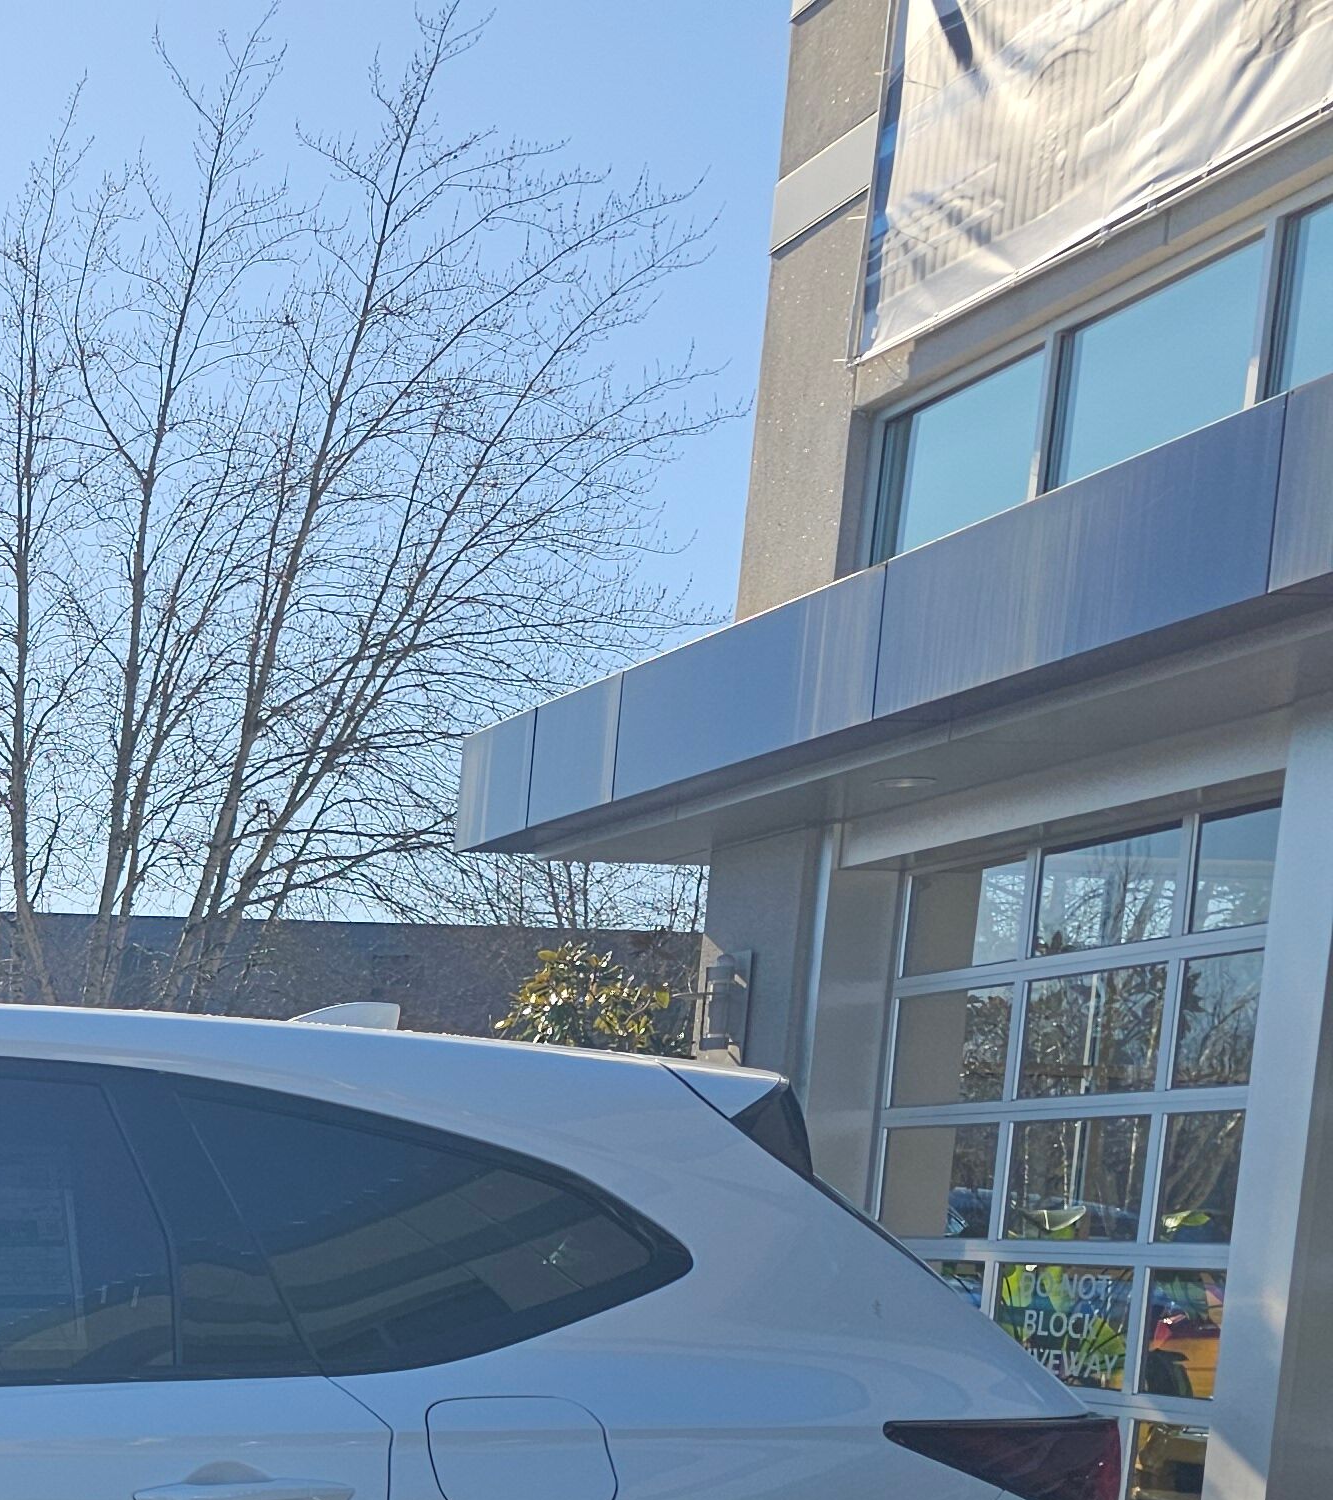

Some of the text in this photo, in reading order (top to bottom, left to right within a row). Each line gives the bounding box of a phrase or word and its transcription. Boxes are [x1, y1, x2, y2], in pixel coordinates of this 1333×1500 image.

[1018, 1271, 1112, 1300] DO NOT
[1023, 1309, 1098, 1340] BLOCK
[1027, 1347, 1119, 1379] VEWAY
